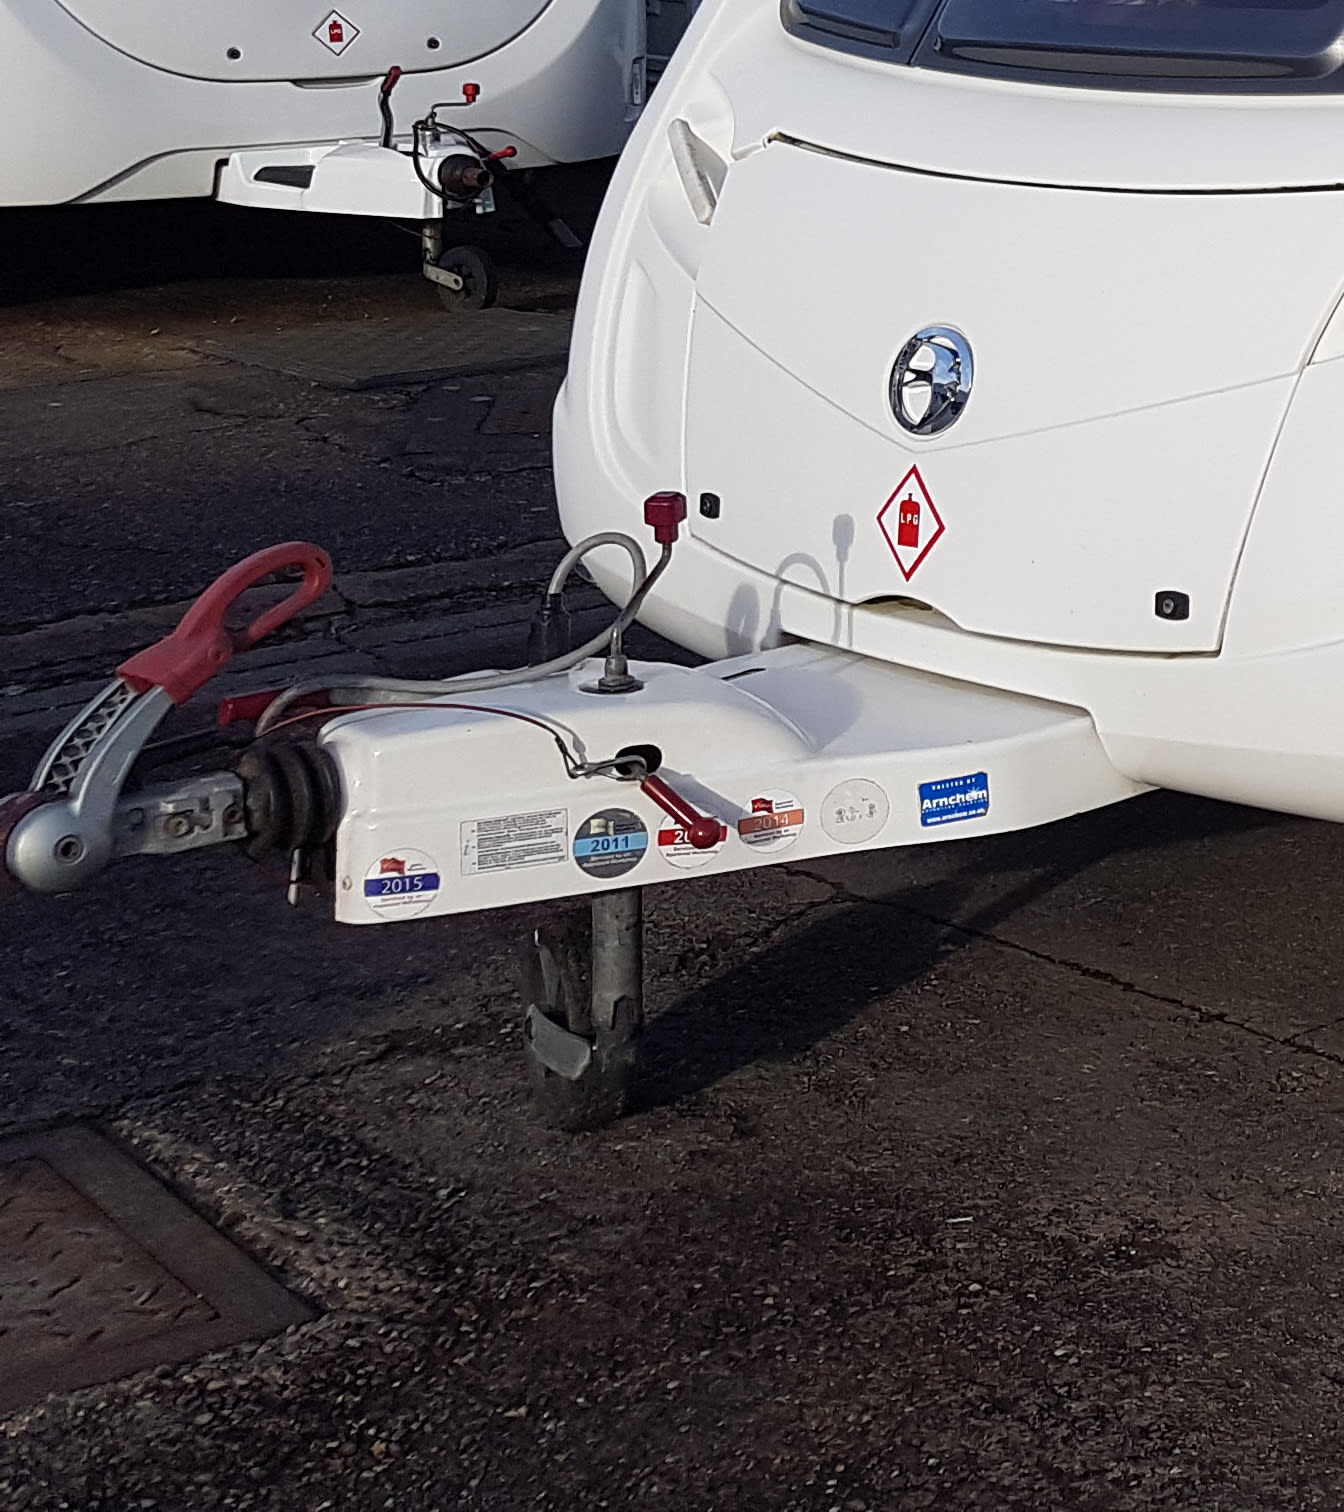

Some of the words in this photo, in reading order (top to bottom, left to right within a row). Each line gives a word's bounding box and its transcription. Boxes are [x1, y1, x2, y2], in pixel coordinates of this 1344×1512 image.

[900, 512, 919, 525] LPG
[922, 788, 988, 810] Arnchem
[754, 813, 790, 832] 2014
[589, 834, 630, 854] 2011
[381, 875, 424, 895] 2015
